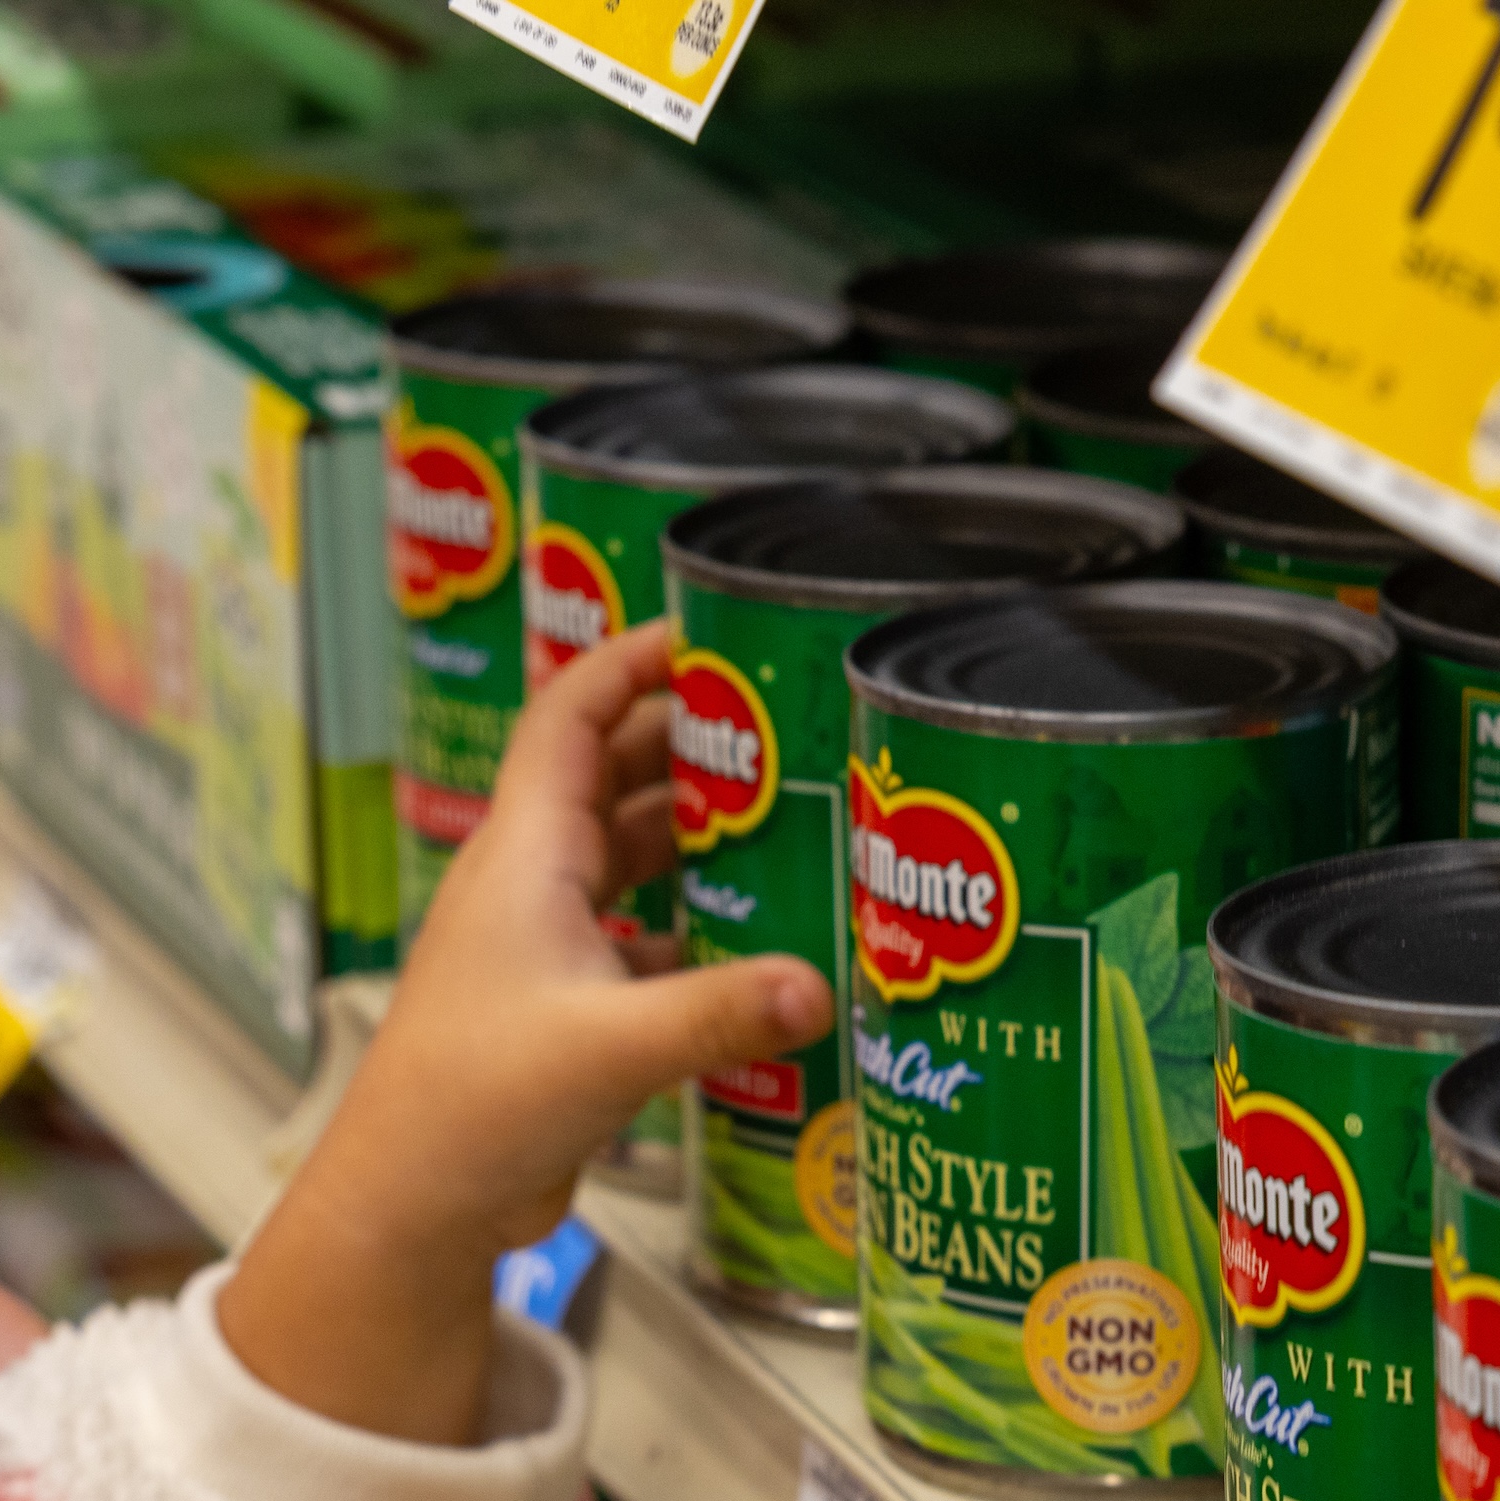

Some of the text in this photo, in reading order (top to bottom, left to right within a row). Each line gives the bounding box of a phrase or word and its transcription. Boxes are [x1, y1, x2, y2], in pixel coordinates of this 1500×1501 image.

[867, 831, 998, 931] Monte
[892, 1040, 984, 1112] Cut
[939, 1009, 1063, 1063] WITH
[908, 1132, 1057, 1227] STYLE
[1221, 1135, 1340, 1254] Monte
[894, 1190, 1045, 1292] BEANS
[1220, 1214, 1270, 1294] Quality
[1066, 1347, 1157, 1377] GMO
[1067, 1314, 1155, 1345] NON
[1286, 1341, 1414, 1406] WITH
[1244, 1373, 1333, 1456] Cut
